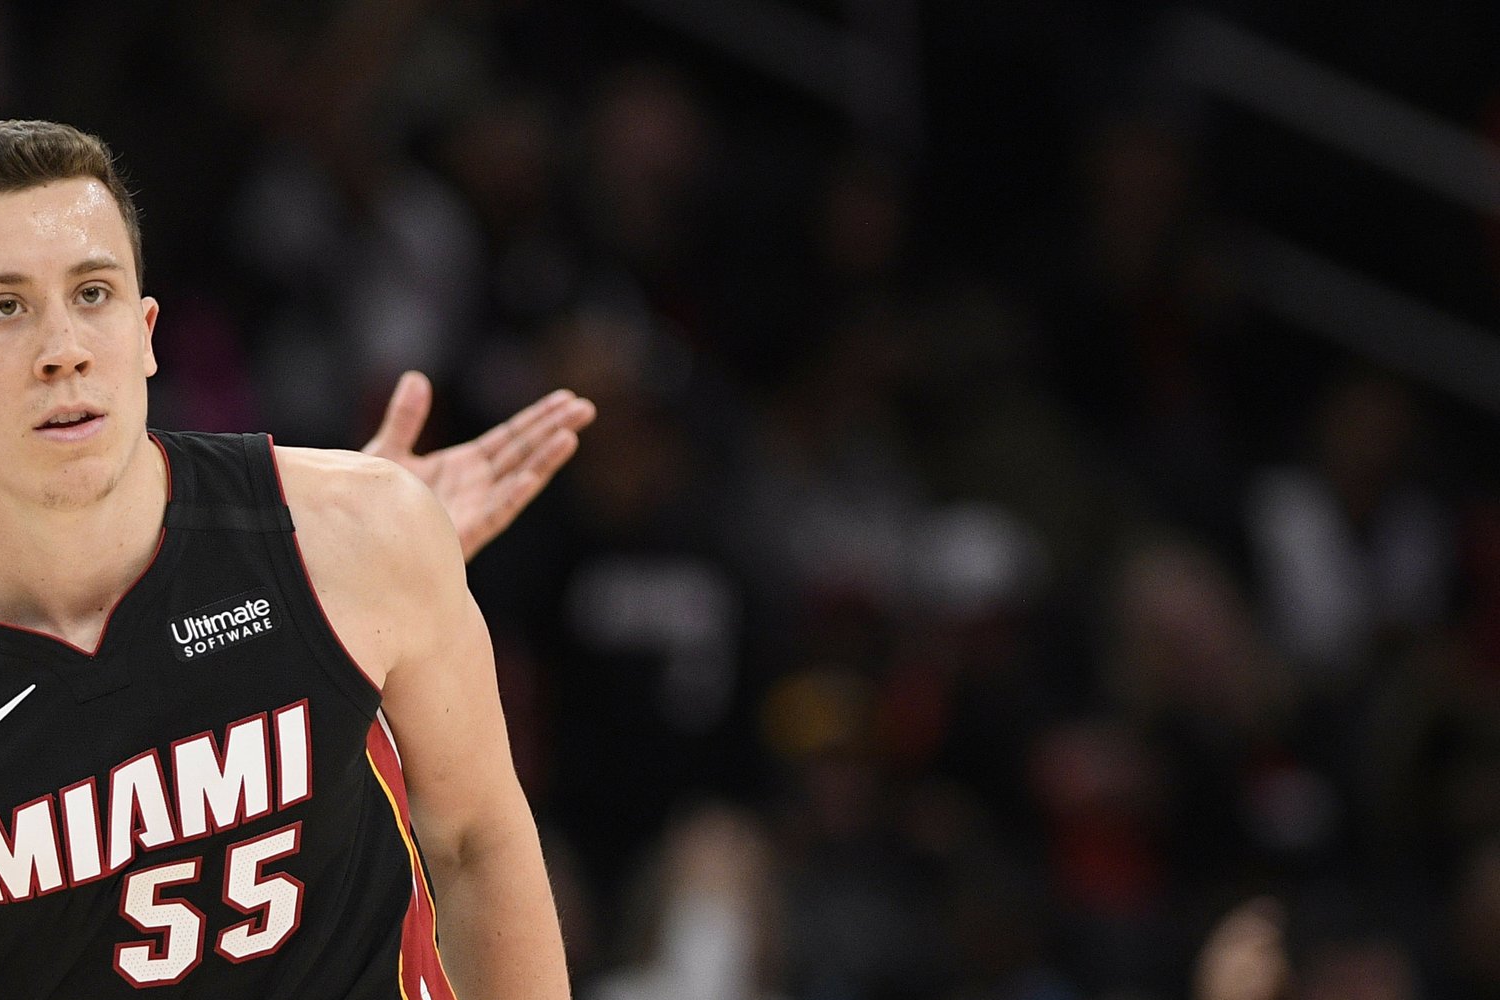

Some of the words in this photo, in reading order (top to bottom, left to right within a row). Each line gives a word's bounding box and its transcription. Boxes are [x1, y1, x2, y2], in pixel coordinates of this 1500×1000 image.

[171, 599, 271, 645] Ultimate
[184, 617, 273, 658] SOFTWARE
[113, 820, 305, 989] 55
